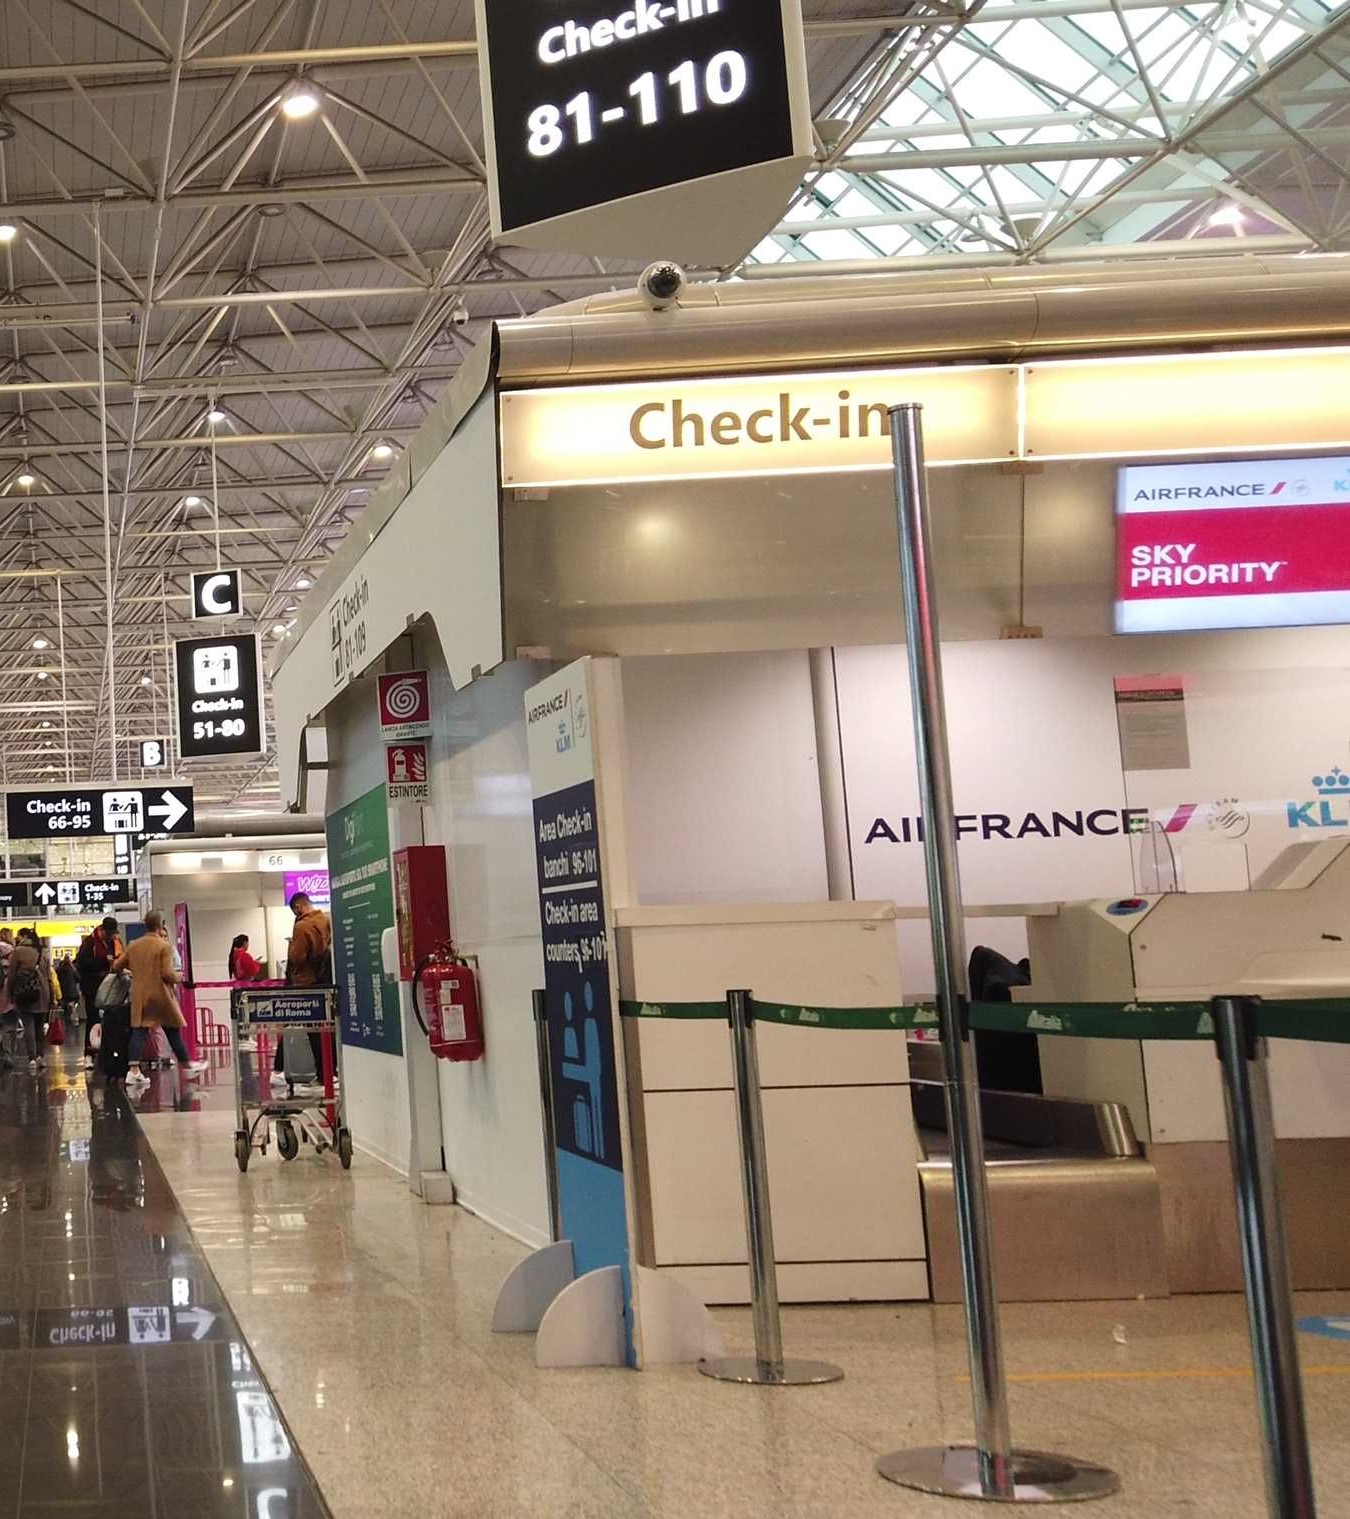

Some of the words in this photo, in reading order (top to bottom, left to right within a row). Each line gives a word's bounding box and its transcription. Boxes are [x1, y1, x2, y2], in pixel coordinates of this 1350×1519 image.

[527, 49, 748, 157] 81-110
[629, 389, 893, 450] Check-in
[1133, 483, 1265, 501] AIRFRANCE
[1130, 543, 1196, 566] SKY
[1130, 561, 1281, 588] PRIORITY
[201, 574, 232, 614] C
[191, 696, 244, 714] Check-in
[193, 718, 246, 740] 51-80
[143, 741, 161, 766] B
[389, 784, 428, 798] ESTINTORE
[26, 798, 91, 815] Check-in
[1286, 800, 1350, 829] KL
[48, 815, 91, 830] 66-95
[539, 818, 556, 843] Area
[556, 809, 593, 835] Check-in
[864, 808, 1150, 844] AIFRANCE
[84, 884, 120, 893] Check-in
[545, 903, 579, 926] Check-in
[579, 906, 599, 922] area
